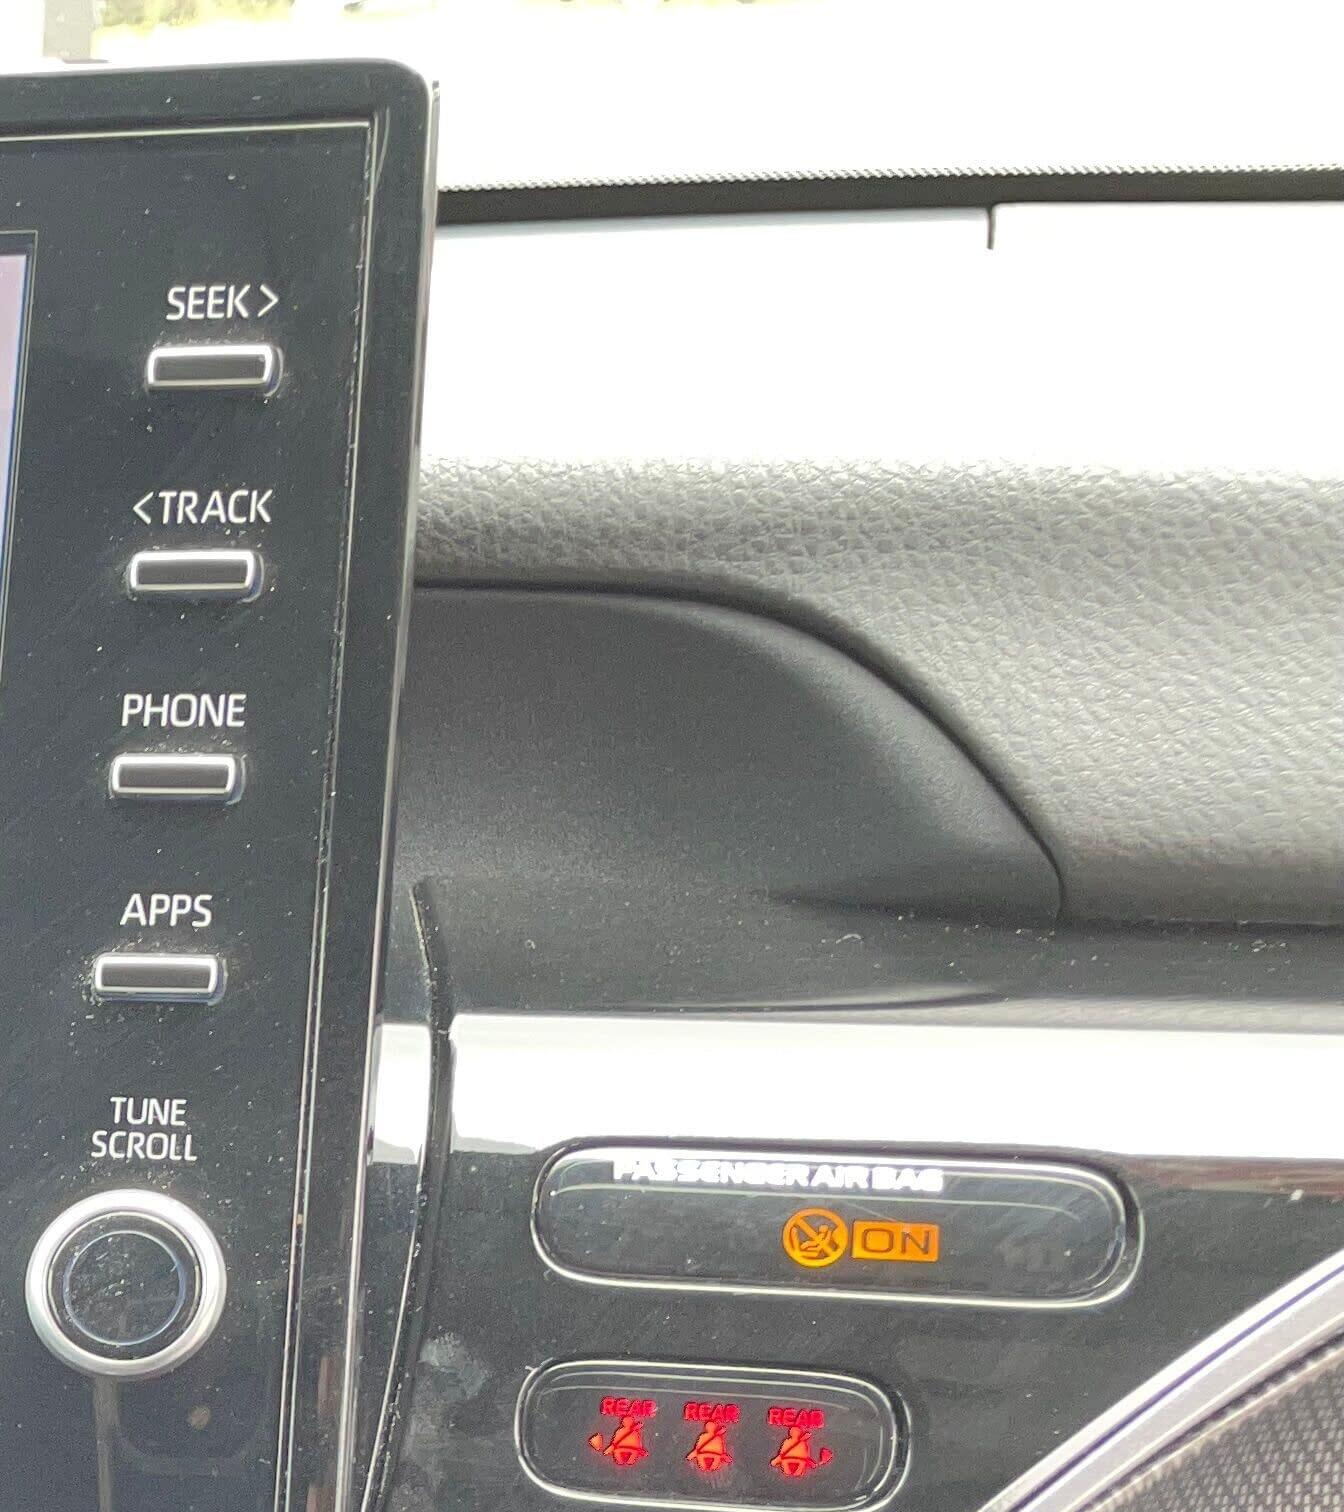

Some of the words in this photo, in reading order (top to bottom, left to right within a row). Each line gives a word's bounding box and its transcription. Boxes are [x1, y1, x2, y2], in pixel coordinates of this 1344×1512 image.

[121, 693, 247, 728] PHONE
[120, 893, 212, 928] APPS
[110, 1096, 188, 1127] TUNE
[90, 1130, 198, 1162] SCROLL
[811, 1164, 870, 1190] AIR
[863, 1228, 931, 1255] ON
